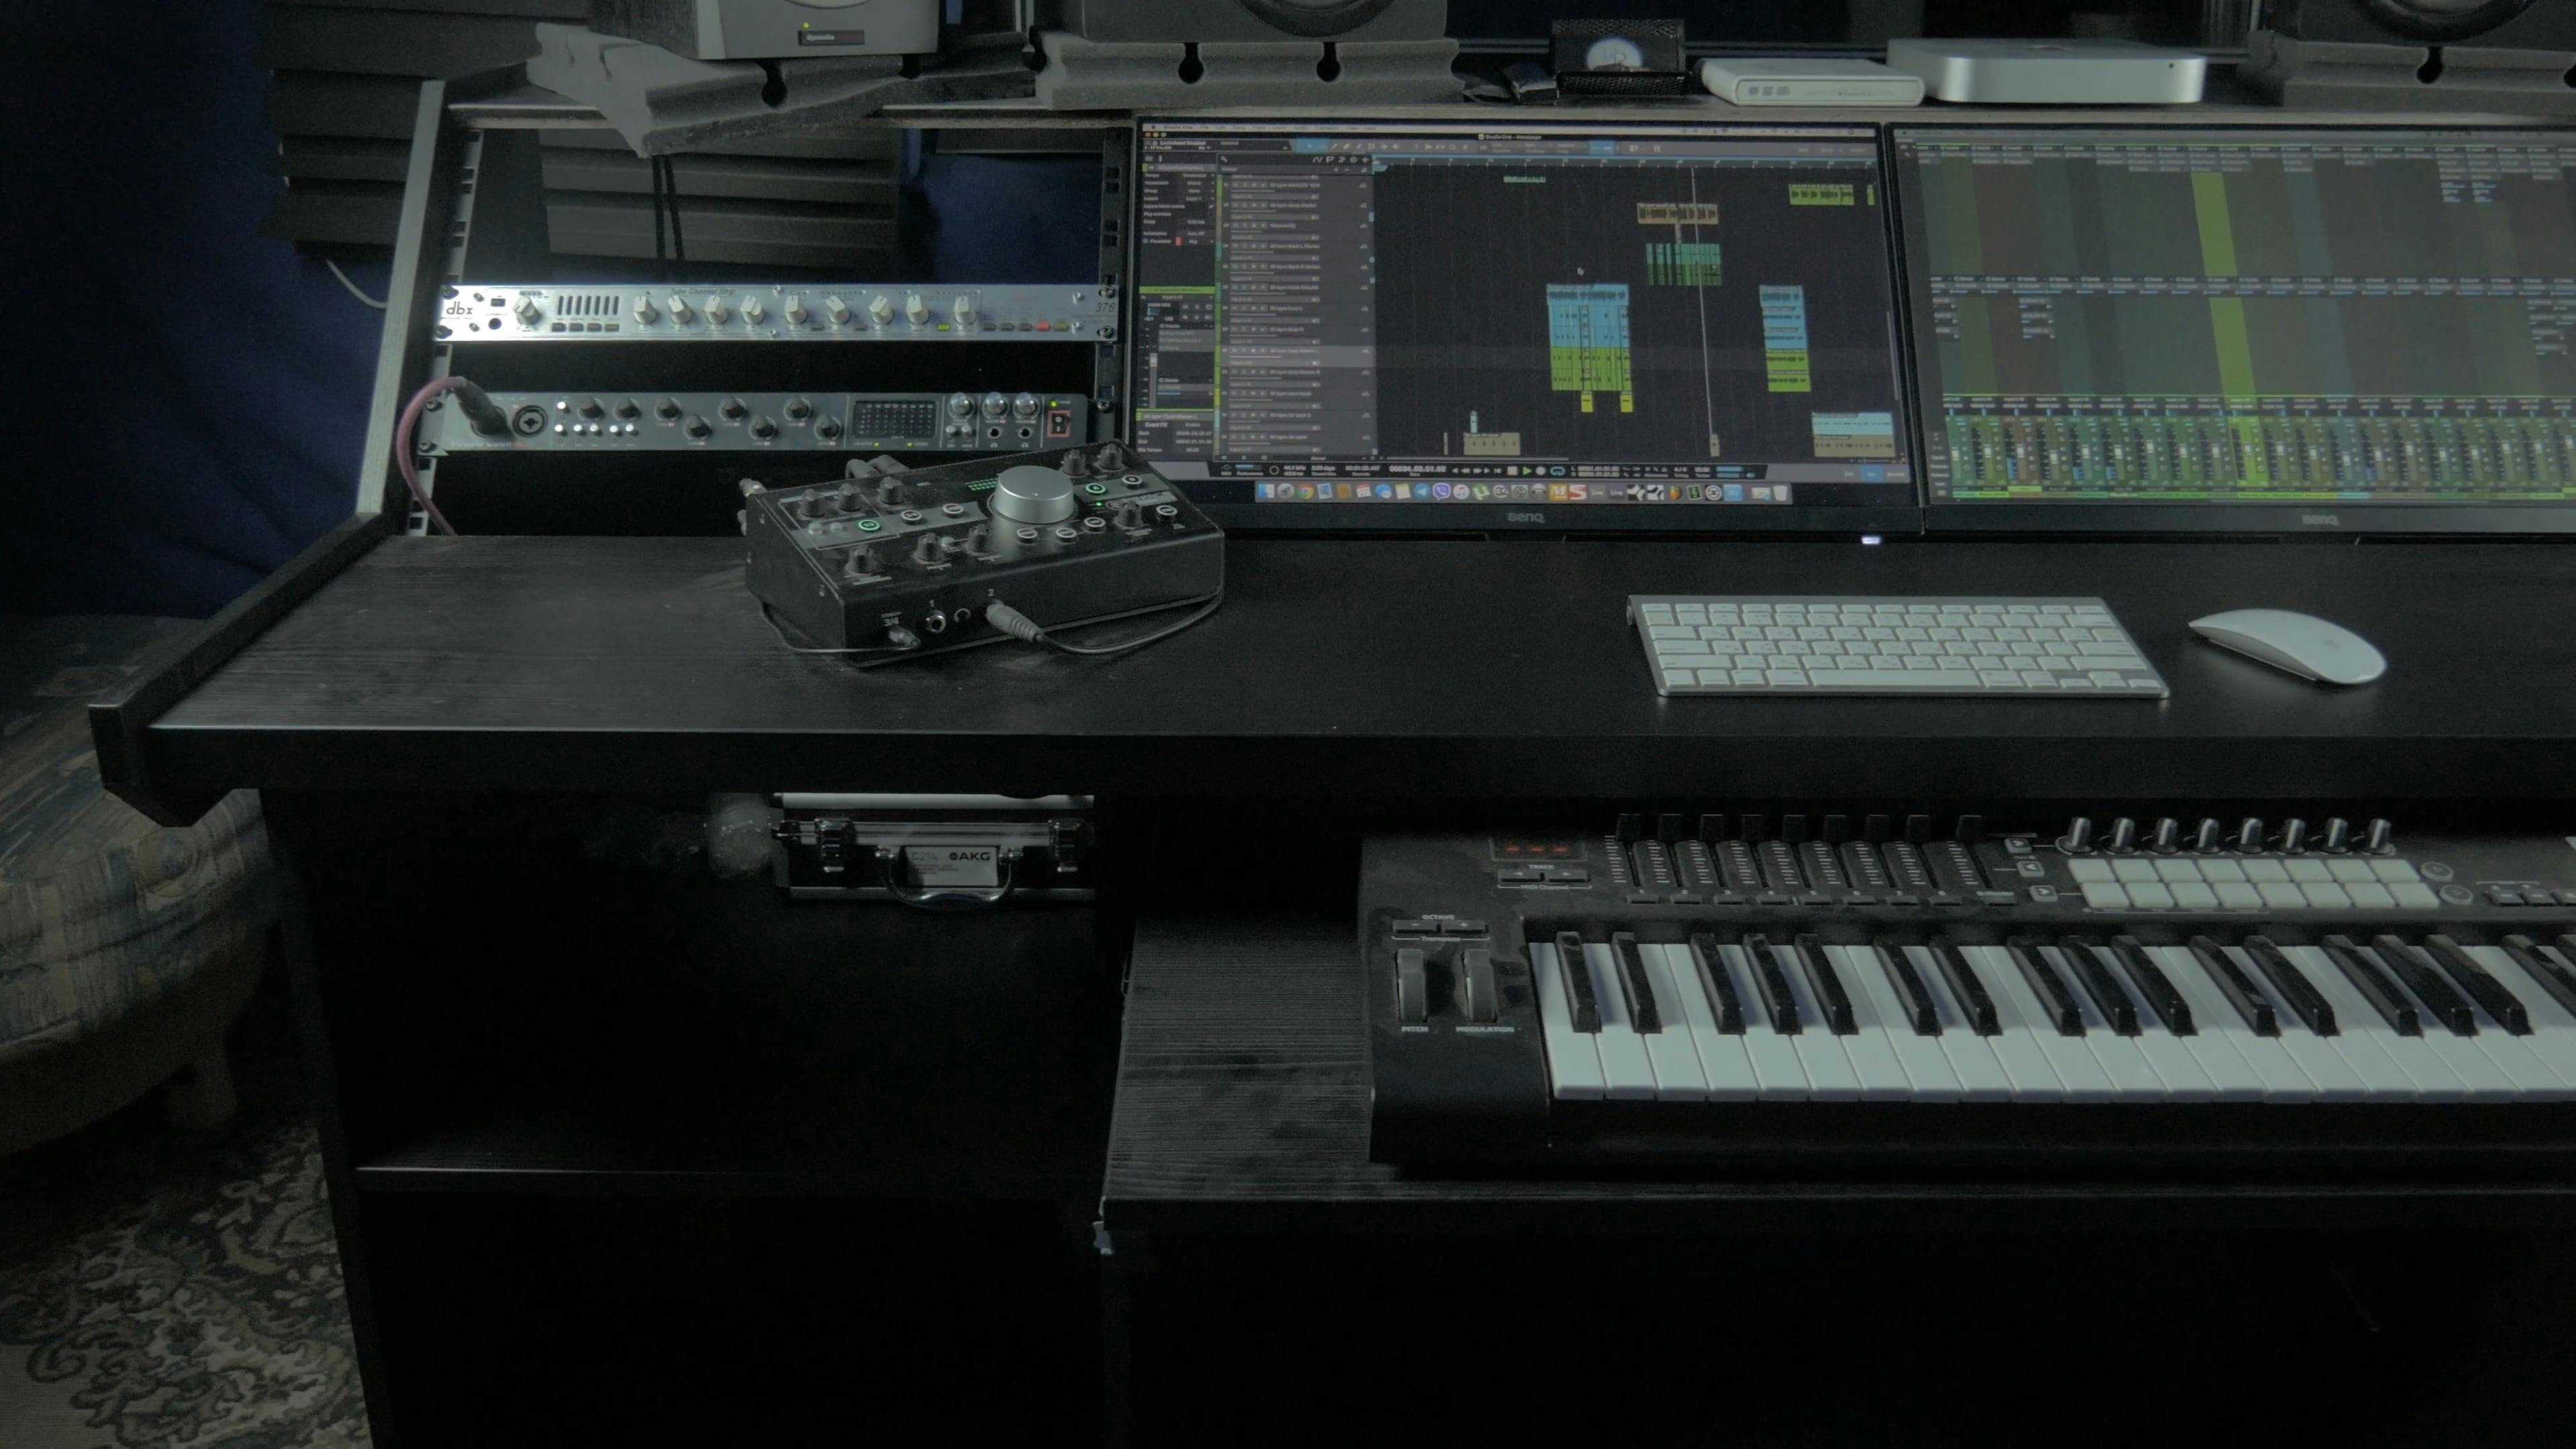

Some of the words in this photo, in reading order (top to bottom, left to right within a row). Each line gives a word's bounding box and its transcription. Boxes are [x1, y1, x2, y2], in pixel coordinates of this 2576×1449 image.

[718, 288, 736, 297] Strip
[446, 301, 474, 315] dbx
[1095, 303, 1116, 313] 376
[1507, 513, 1546, 523] BenQ
[2302, 515, 2340, 526] BenQ
[959, 852, 990, 861] AKG
